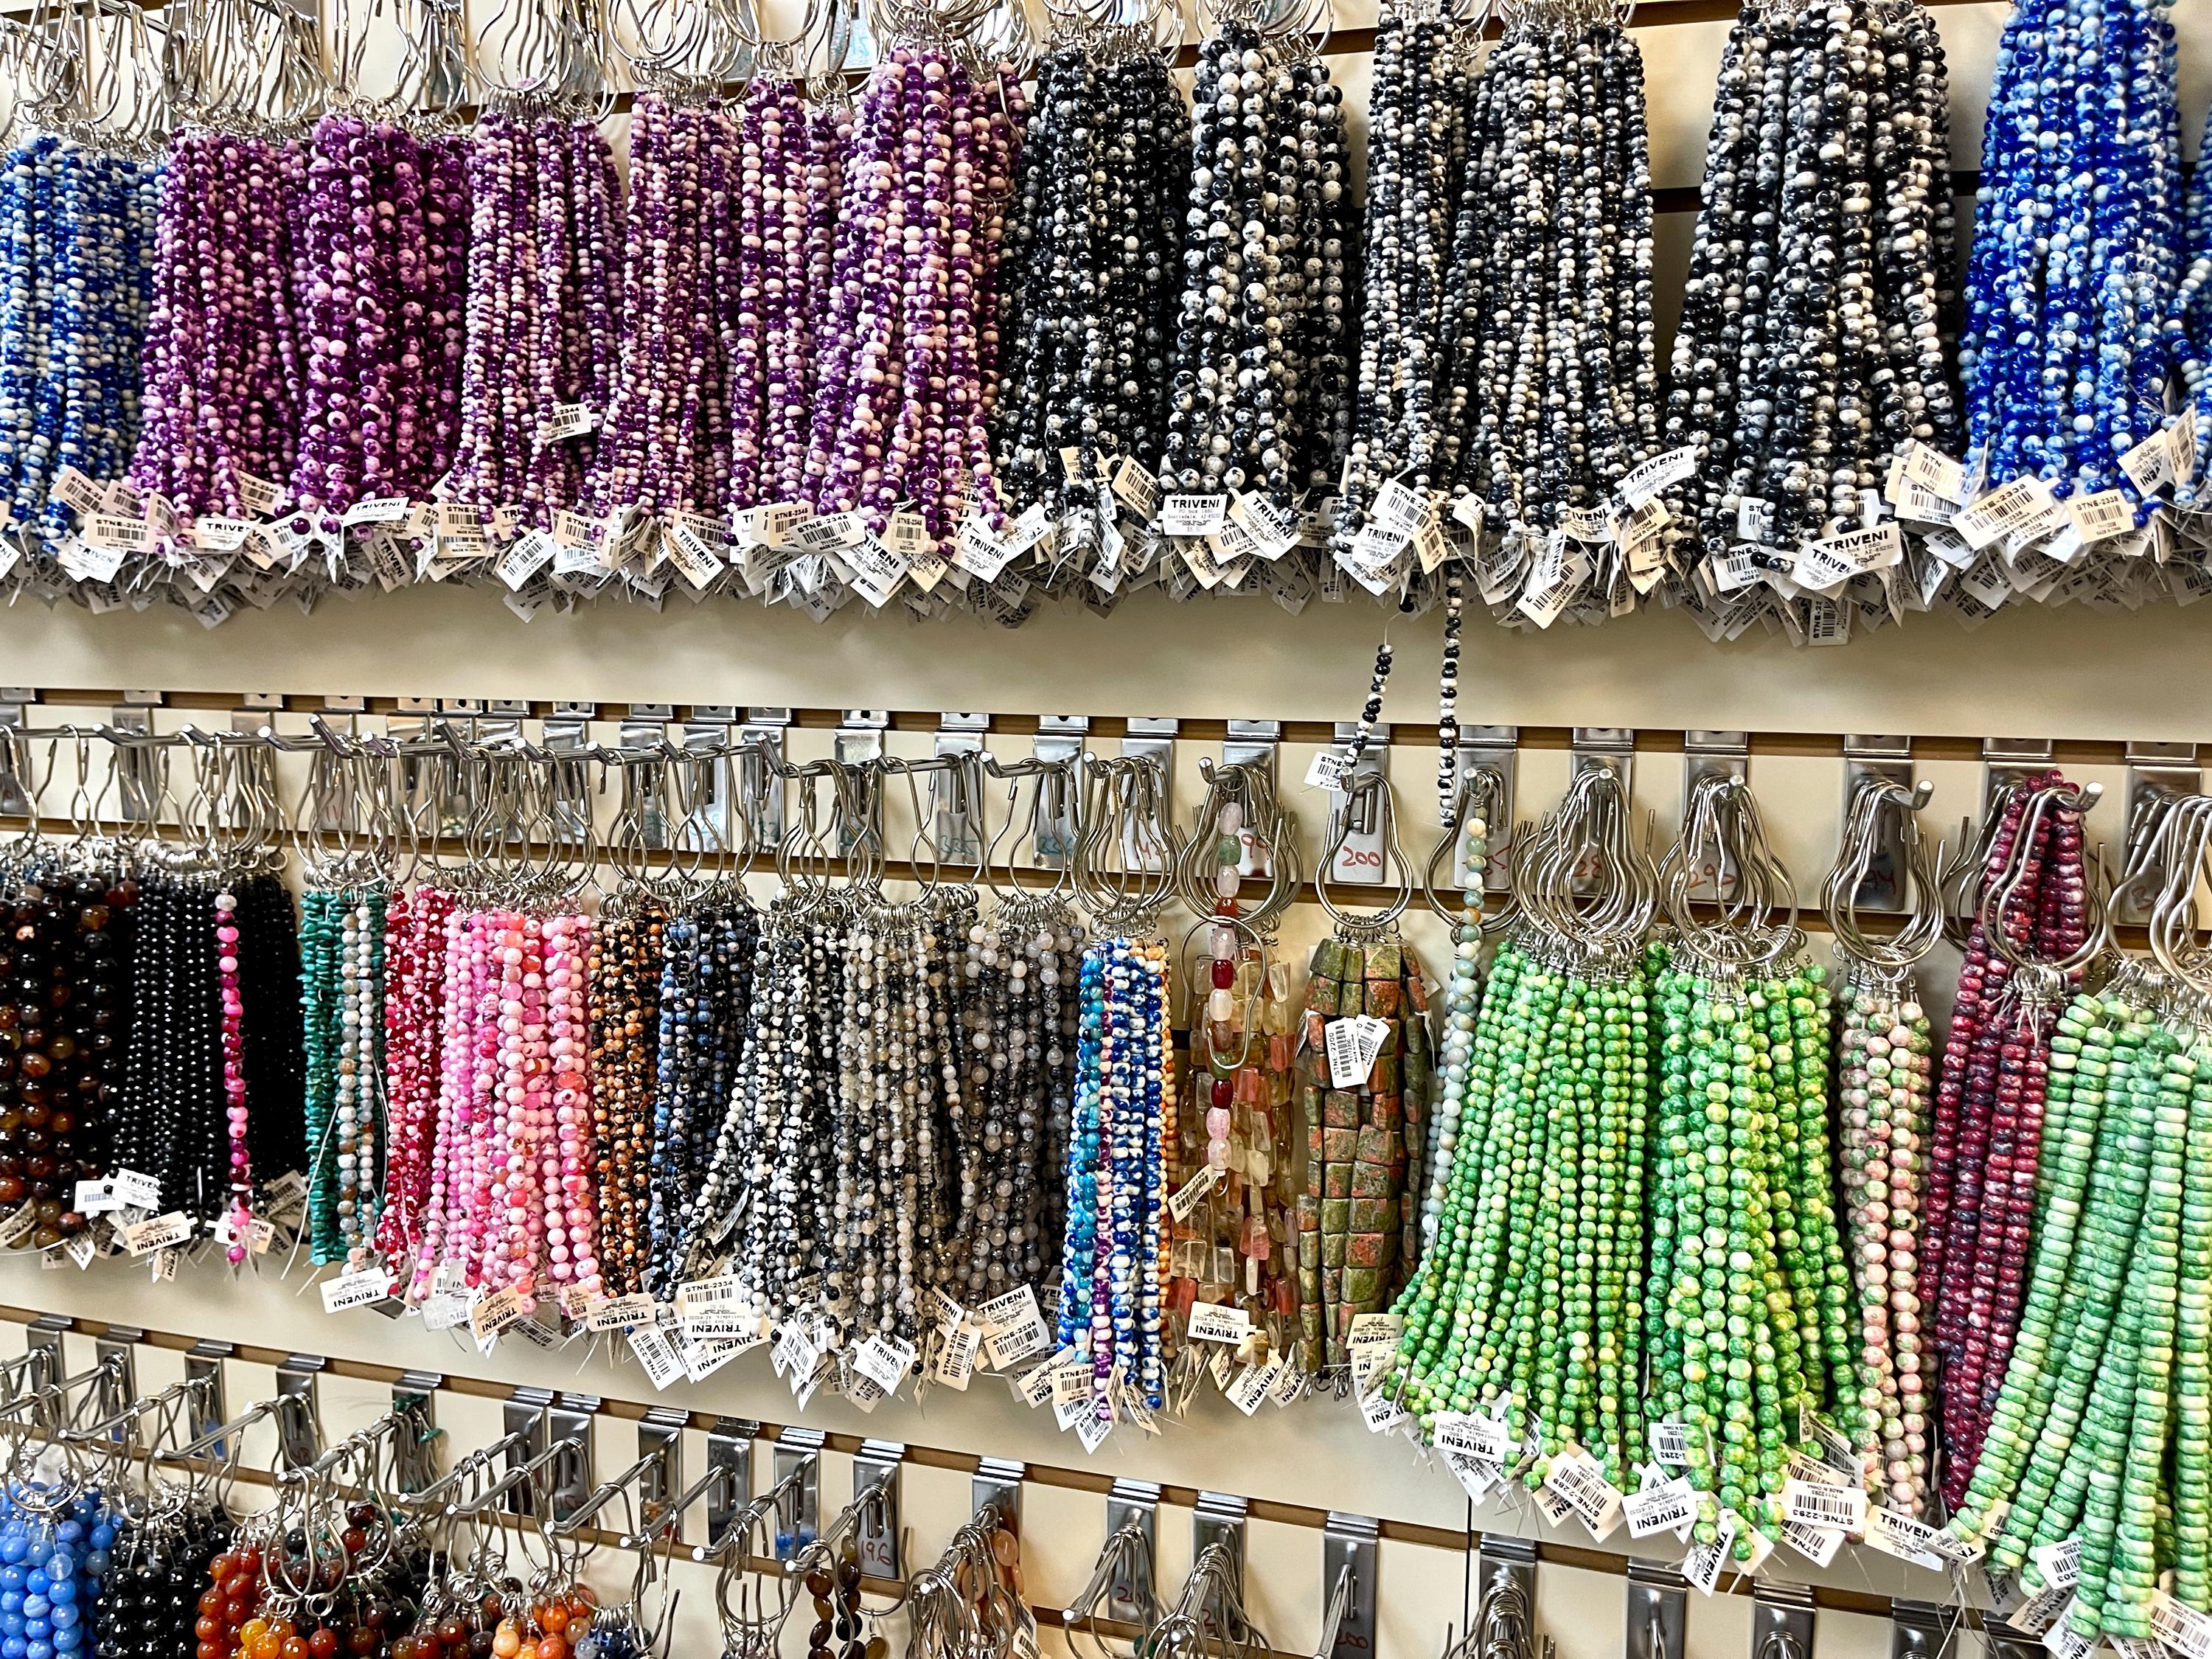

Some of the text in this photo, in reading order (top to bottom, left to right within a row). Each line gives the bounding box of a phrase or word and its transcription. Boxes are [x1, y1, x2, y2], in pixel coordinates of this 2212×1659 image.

[1129, 462, 1158, 489] STNE-2
[1627, 449, 1685, 483] TRIVENI
[69, 475, 104, 501] STNE-23
[356, 501, 400, 510] TRIVENI
[1171, 498, 1220, 509] TRIVENI
[1391, 487, 1434, 515] STNE-234
[1962, 482, 2027, 521] STNE-2338
[2076, 495, 2119, 511] STNE-2338
[681, 515, 726, 532] STNE-2344
[1251, 496, 1293, 540] TRIVENI
[1571, 508, 1607, 522] IVENI
[206, 522, 244, 532] TRIVE
[1366, 526, 1405, 545] TRIVENI
[676, 529, 715, 569] TRIVENI
[966, 534, 1004, 560] TRIVENI
[1822, 529, 1889, 552] TRIVENI
[1863, 540, 1881, 549] 1660
[75, 543, 115, 564] TRIVENI
[378, 536, 406, 578] TRIVENI
[1721, 545, 1760, 560] STNE-
[1809, 547, 1851, 576] TRIVEN
[976, 580, 987, 608] VENI
[1341, 845, 1381, 867] 200
[1327, 1032, 1340, 1075] STNE-2200
[136, 1231, 181, 1251] TRIVENI
[333, 1287, 380, 1308] TRIVENI
[684, 1280, 733, 1293] STNE-2334
[933, 1295, 959, 1318] IVENI
[978, 1290, 1026, 1315] TRIVENI
[480, 1306, 517, 1332] TRIVENI
[596, 1310, 647, 1326] TRIVENI
[692, 1324, 741, 1332] TRIVENI
[991, 1320, 1037, 1346] STNE-2236
[1195, 1325, 1239, 1339] TRIVENI
[1352, 1335, 1390, 1343] RIVENI
[633, 1337, 661, 1382] STNE-2332
[870, 1340, 903, 1371] TRIVENI
[1008, 1353, 1020, 1361] MADE
[1024, 1345, 1036, 1354] CHINA
[1059, 1367, 1093, 1379] STNE-234
[1245, 1365, 1279, 1408] TRIVENI
[1280, 1373, 1306, 1403] IVENI
[1077, 1399, 1102, 1428] STNE-234
[1440, 1433, 1496, 1455] TRIVENI
[1798, 1455, 1812, 1464] CHINA
[1815, 1463, 1830, 1473] MADE
[1551, 1476, 1600, 1517] STNE-2289
[1635, 1505, 1688, 1529] TRIVENI
[1641, 1509, 1655, 1517] 1660
[1792, 1509, 1854, 1526] STNE-2293
[1877, 1509, 1933, 1543] TRIVEN
[1897, 1529, 1910, 1538] box
[860, 1540, 892, 1566] 196
[1780, 1529, 1820, 1558] STNE-2
[1700, 1530, 1729, 1585] TRIVENI
[2148, 1621, 2205, 1659] STNE-230
